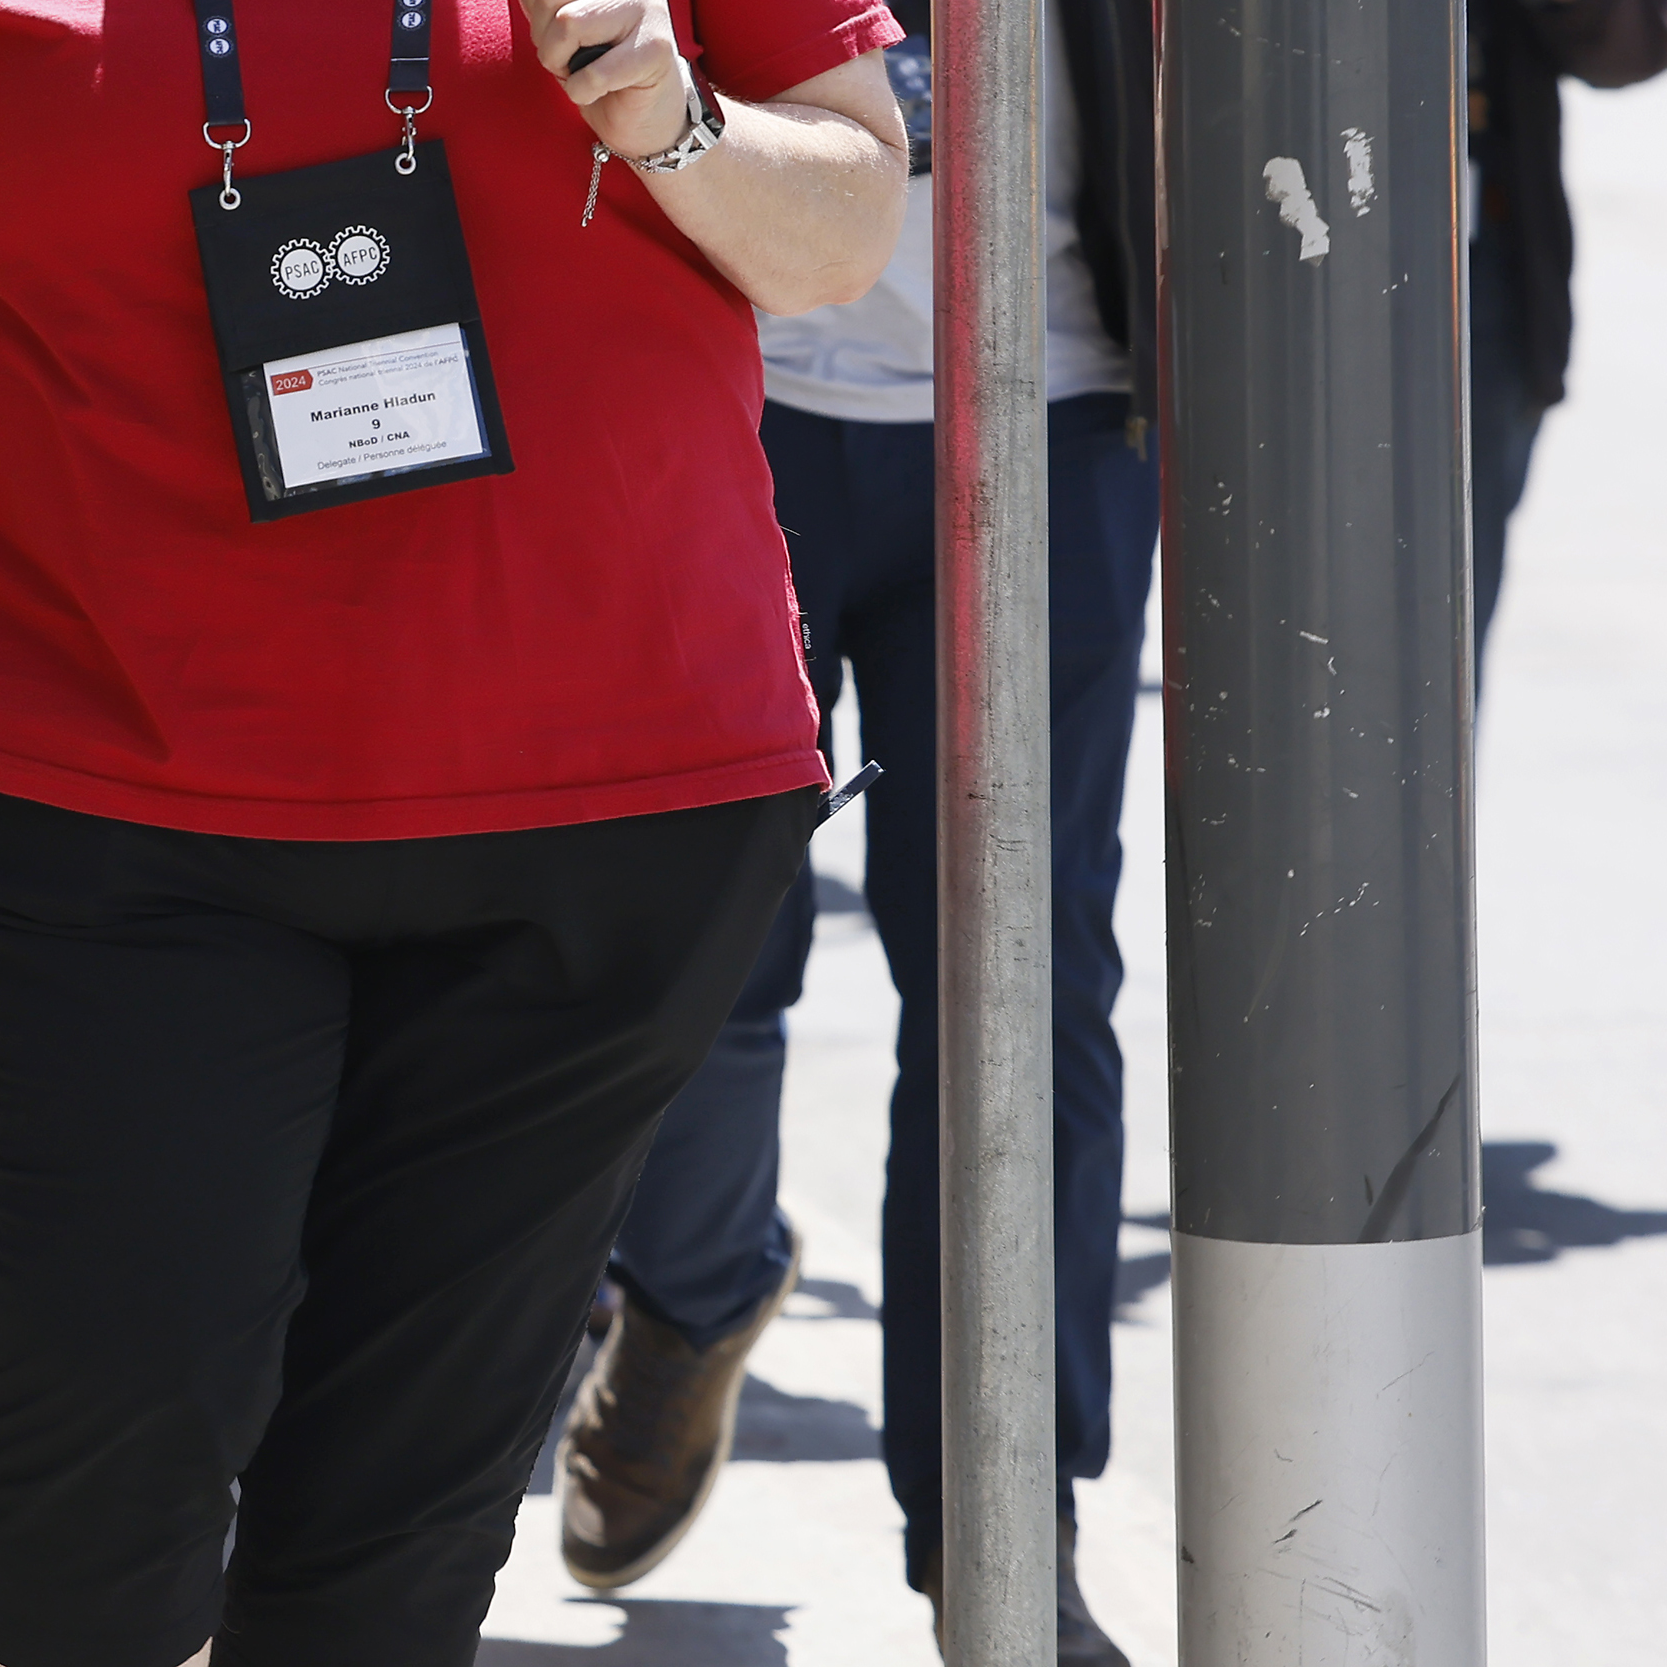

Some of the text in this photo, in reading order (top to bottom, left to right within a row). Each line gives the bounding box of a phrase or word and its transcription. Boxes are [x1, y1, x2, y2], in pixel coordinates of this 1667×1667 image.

[284, 246, 378, 281] PSAC AFPC
[338, 362, 367, 373] National
[399, 350, 439, 363] Convention
[405, 362, 423, 371] 2024
[275, 374, 307, 391] 2024
[310, 392, 437, 423] Marianne Hladun
[372, 418, 381, 430] 9
[348, 436, 378, 449] NBoD
[387, 430, 411, 442] CNA
[317, 456, 357, 470] Delegate
[363, 449, 406, 462] Personne
[407, 440, 447, 454] déléguée
